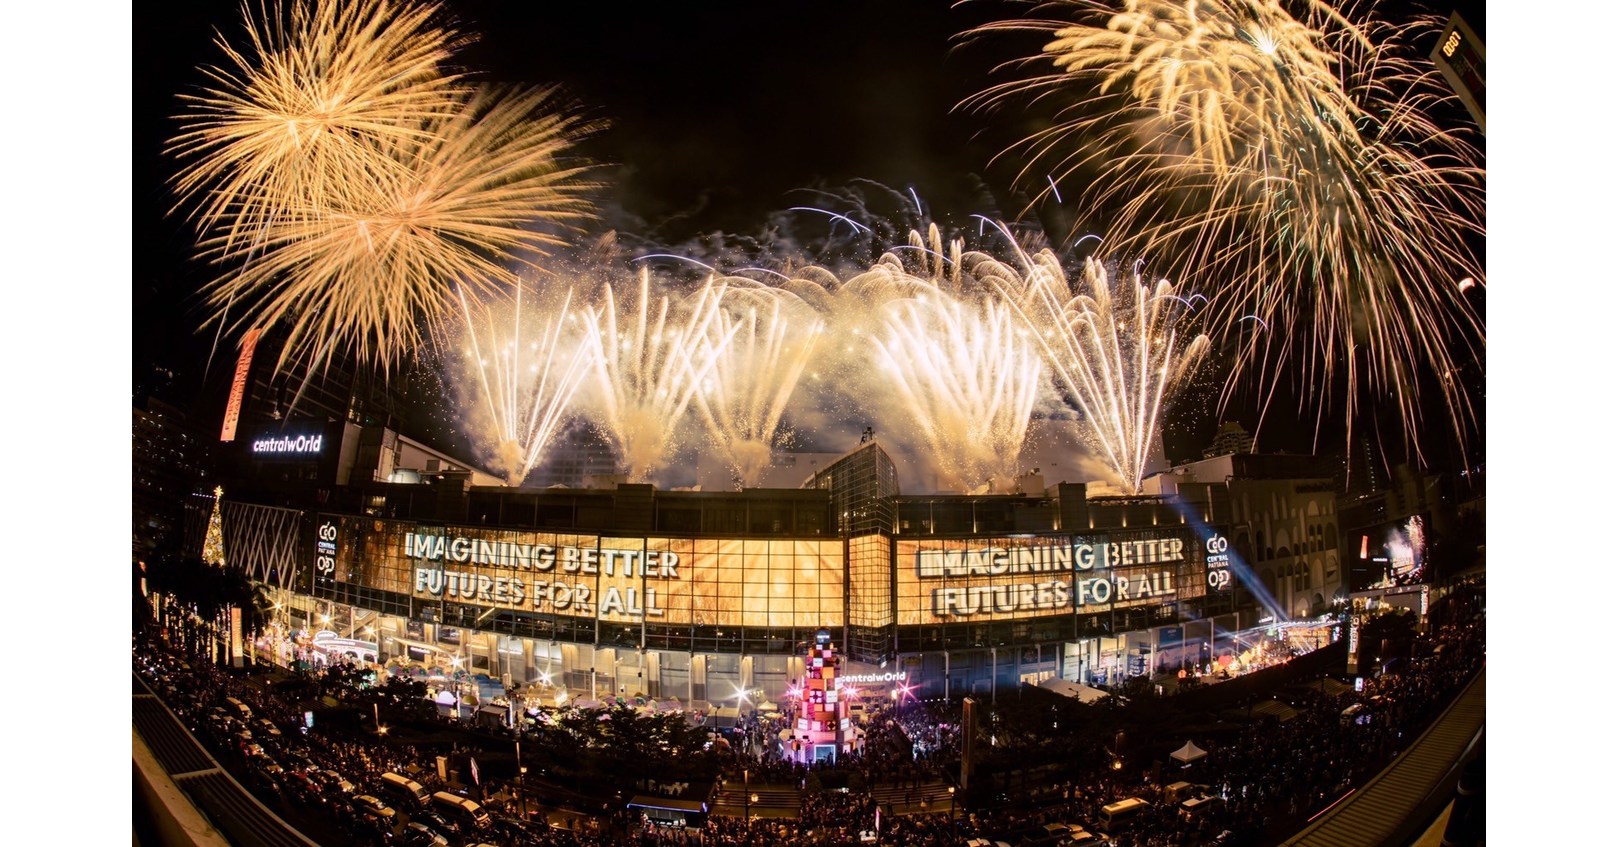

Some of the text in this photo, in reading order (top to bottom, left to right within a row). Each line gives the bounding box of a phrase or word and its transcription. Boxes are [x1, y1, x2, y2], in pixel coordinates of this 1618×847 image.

[253, 434, 322, 452] centralwOrld
[404, 532, 680, 579] IMAGINING BETTER
[915, 544, 1095, 578] IMAGINING
[1103, 537, 1184, 567] BETTER
[415, 567, 664, 617] FUTURES FOR ALL
[934, 581, 1070, 617] FUTURES
[1076, 576, 1130, 606] FOR
[1136, 571, 1176, 599] ALL
